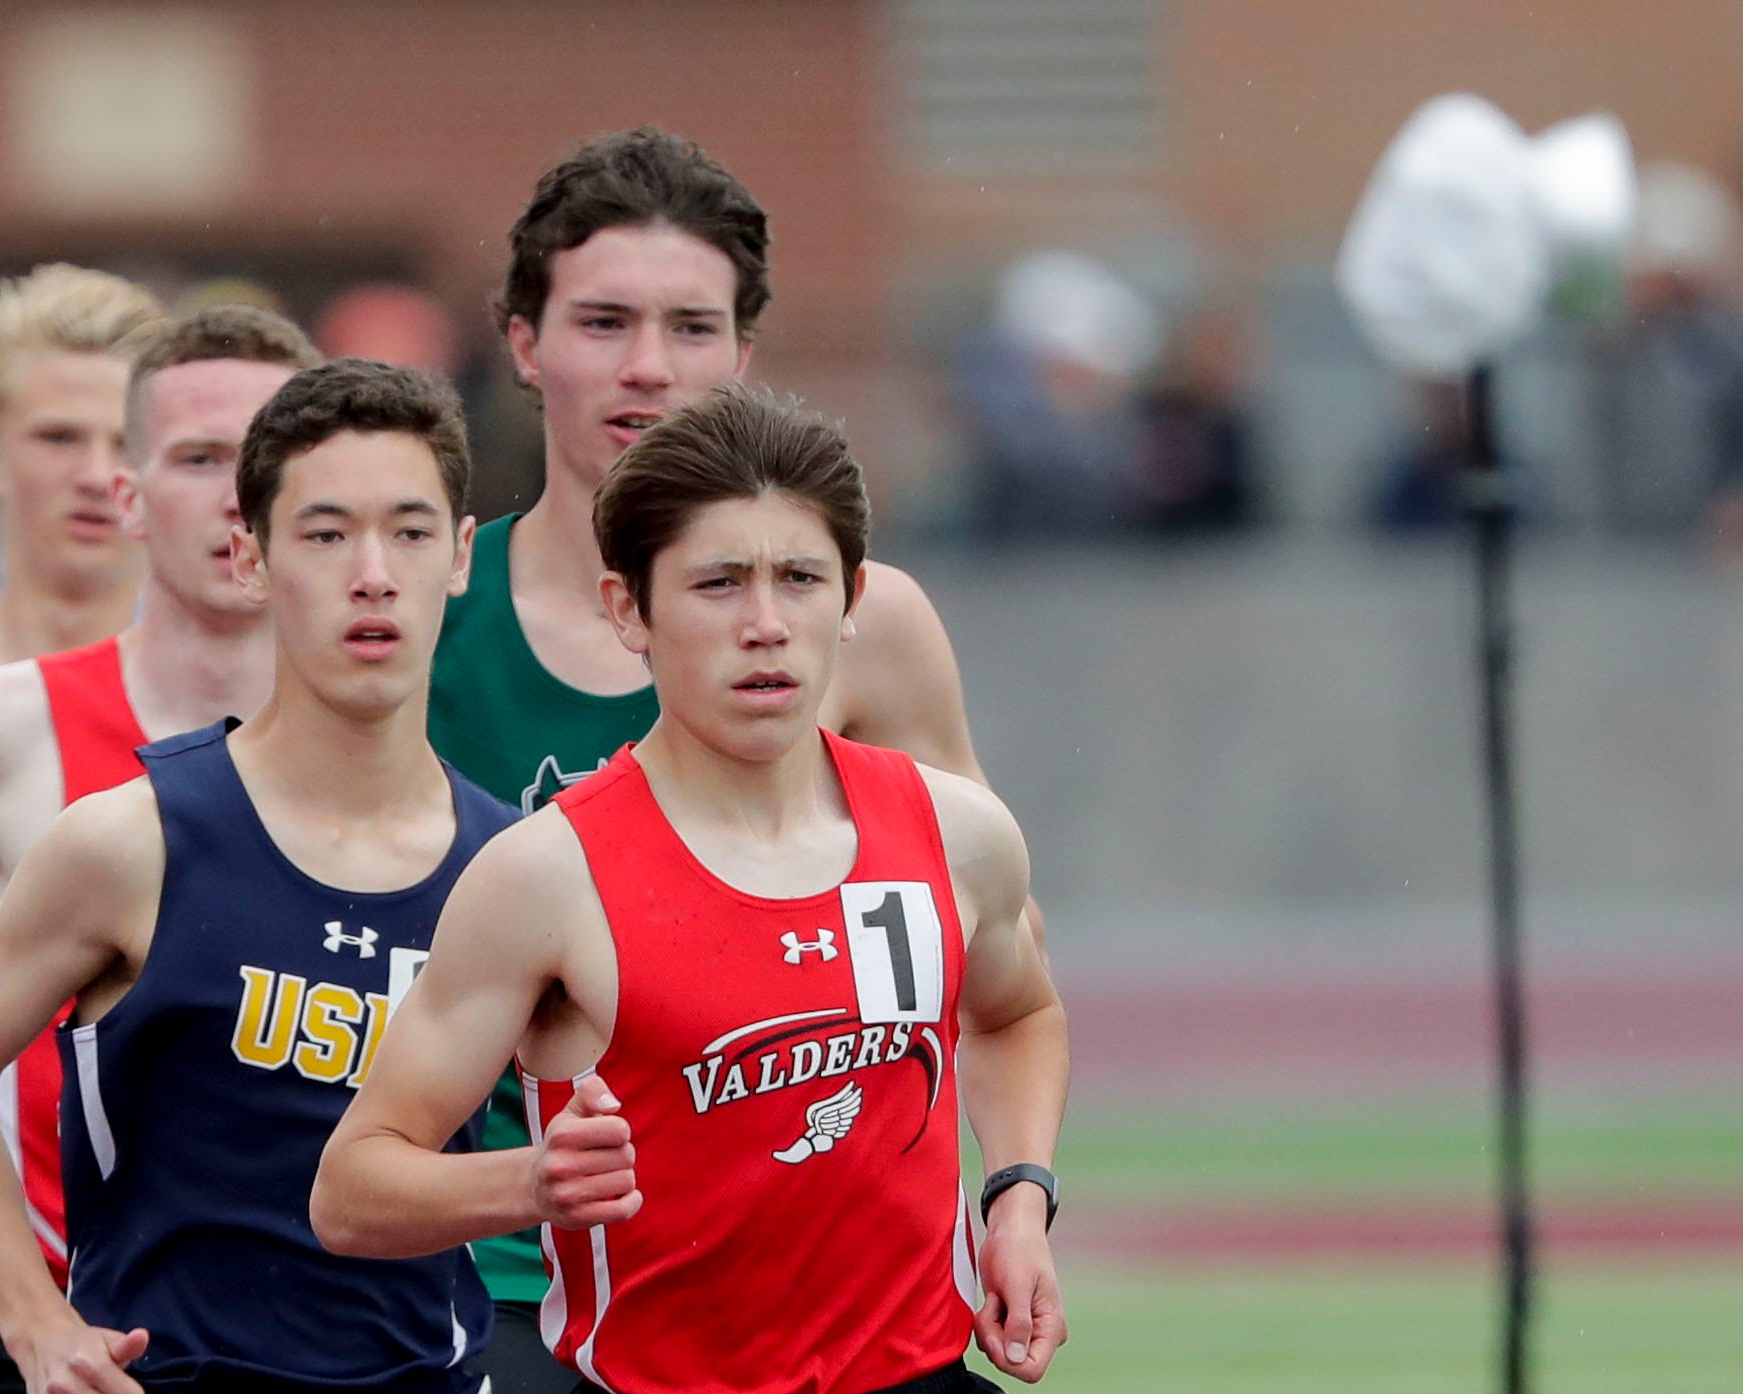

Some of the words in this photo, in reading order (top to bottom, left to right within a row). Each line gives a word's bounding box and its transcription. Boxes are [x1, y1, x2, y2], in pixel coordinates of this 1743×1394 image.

[861, 891, 916, 1011] 1
[231, 964, 389, 1088] US
[682, 1022, 914, 1114] VALDERS
